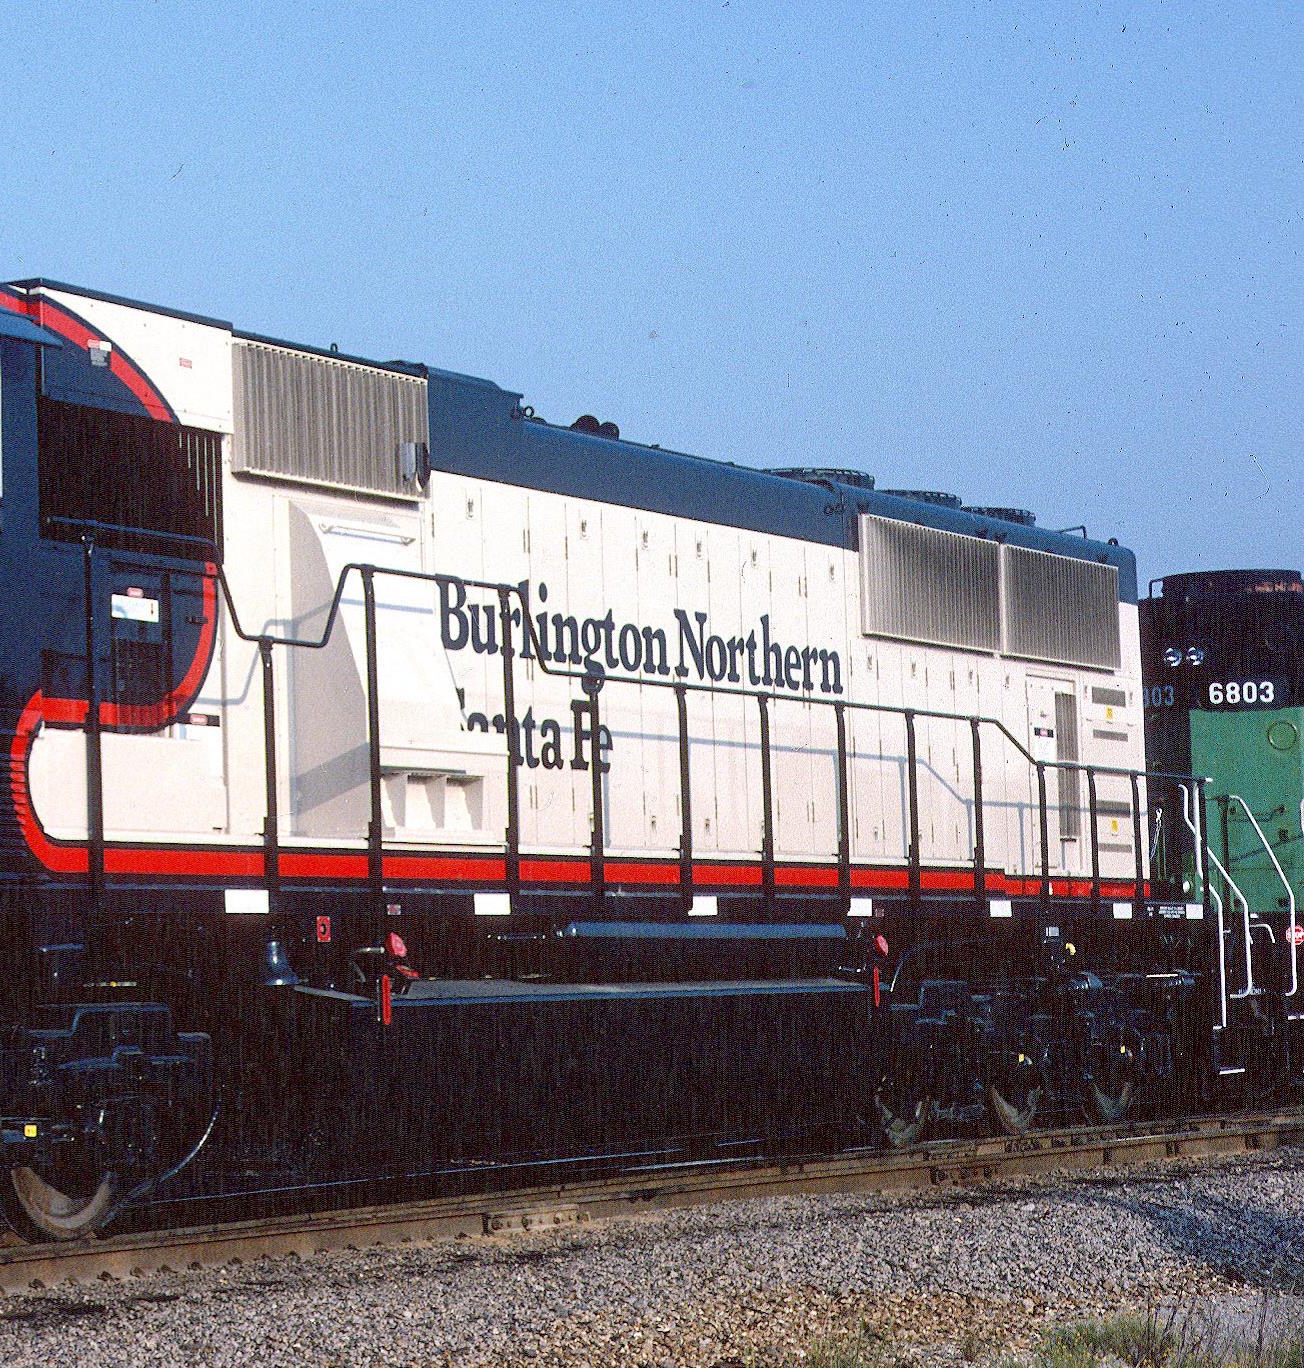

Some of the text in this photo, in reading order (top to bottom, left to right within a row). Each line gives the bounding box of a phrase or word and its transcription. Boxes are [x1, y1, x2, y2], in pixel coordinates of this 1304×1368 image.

[434, 573, 843, 695] Burlington Northern
[1209, 681, 1274, 704] 6803
